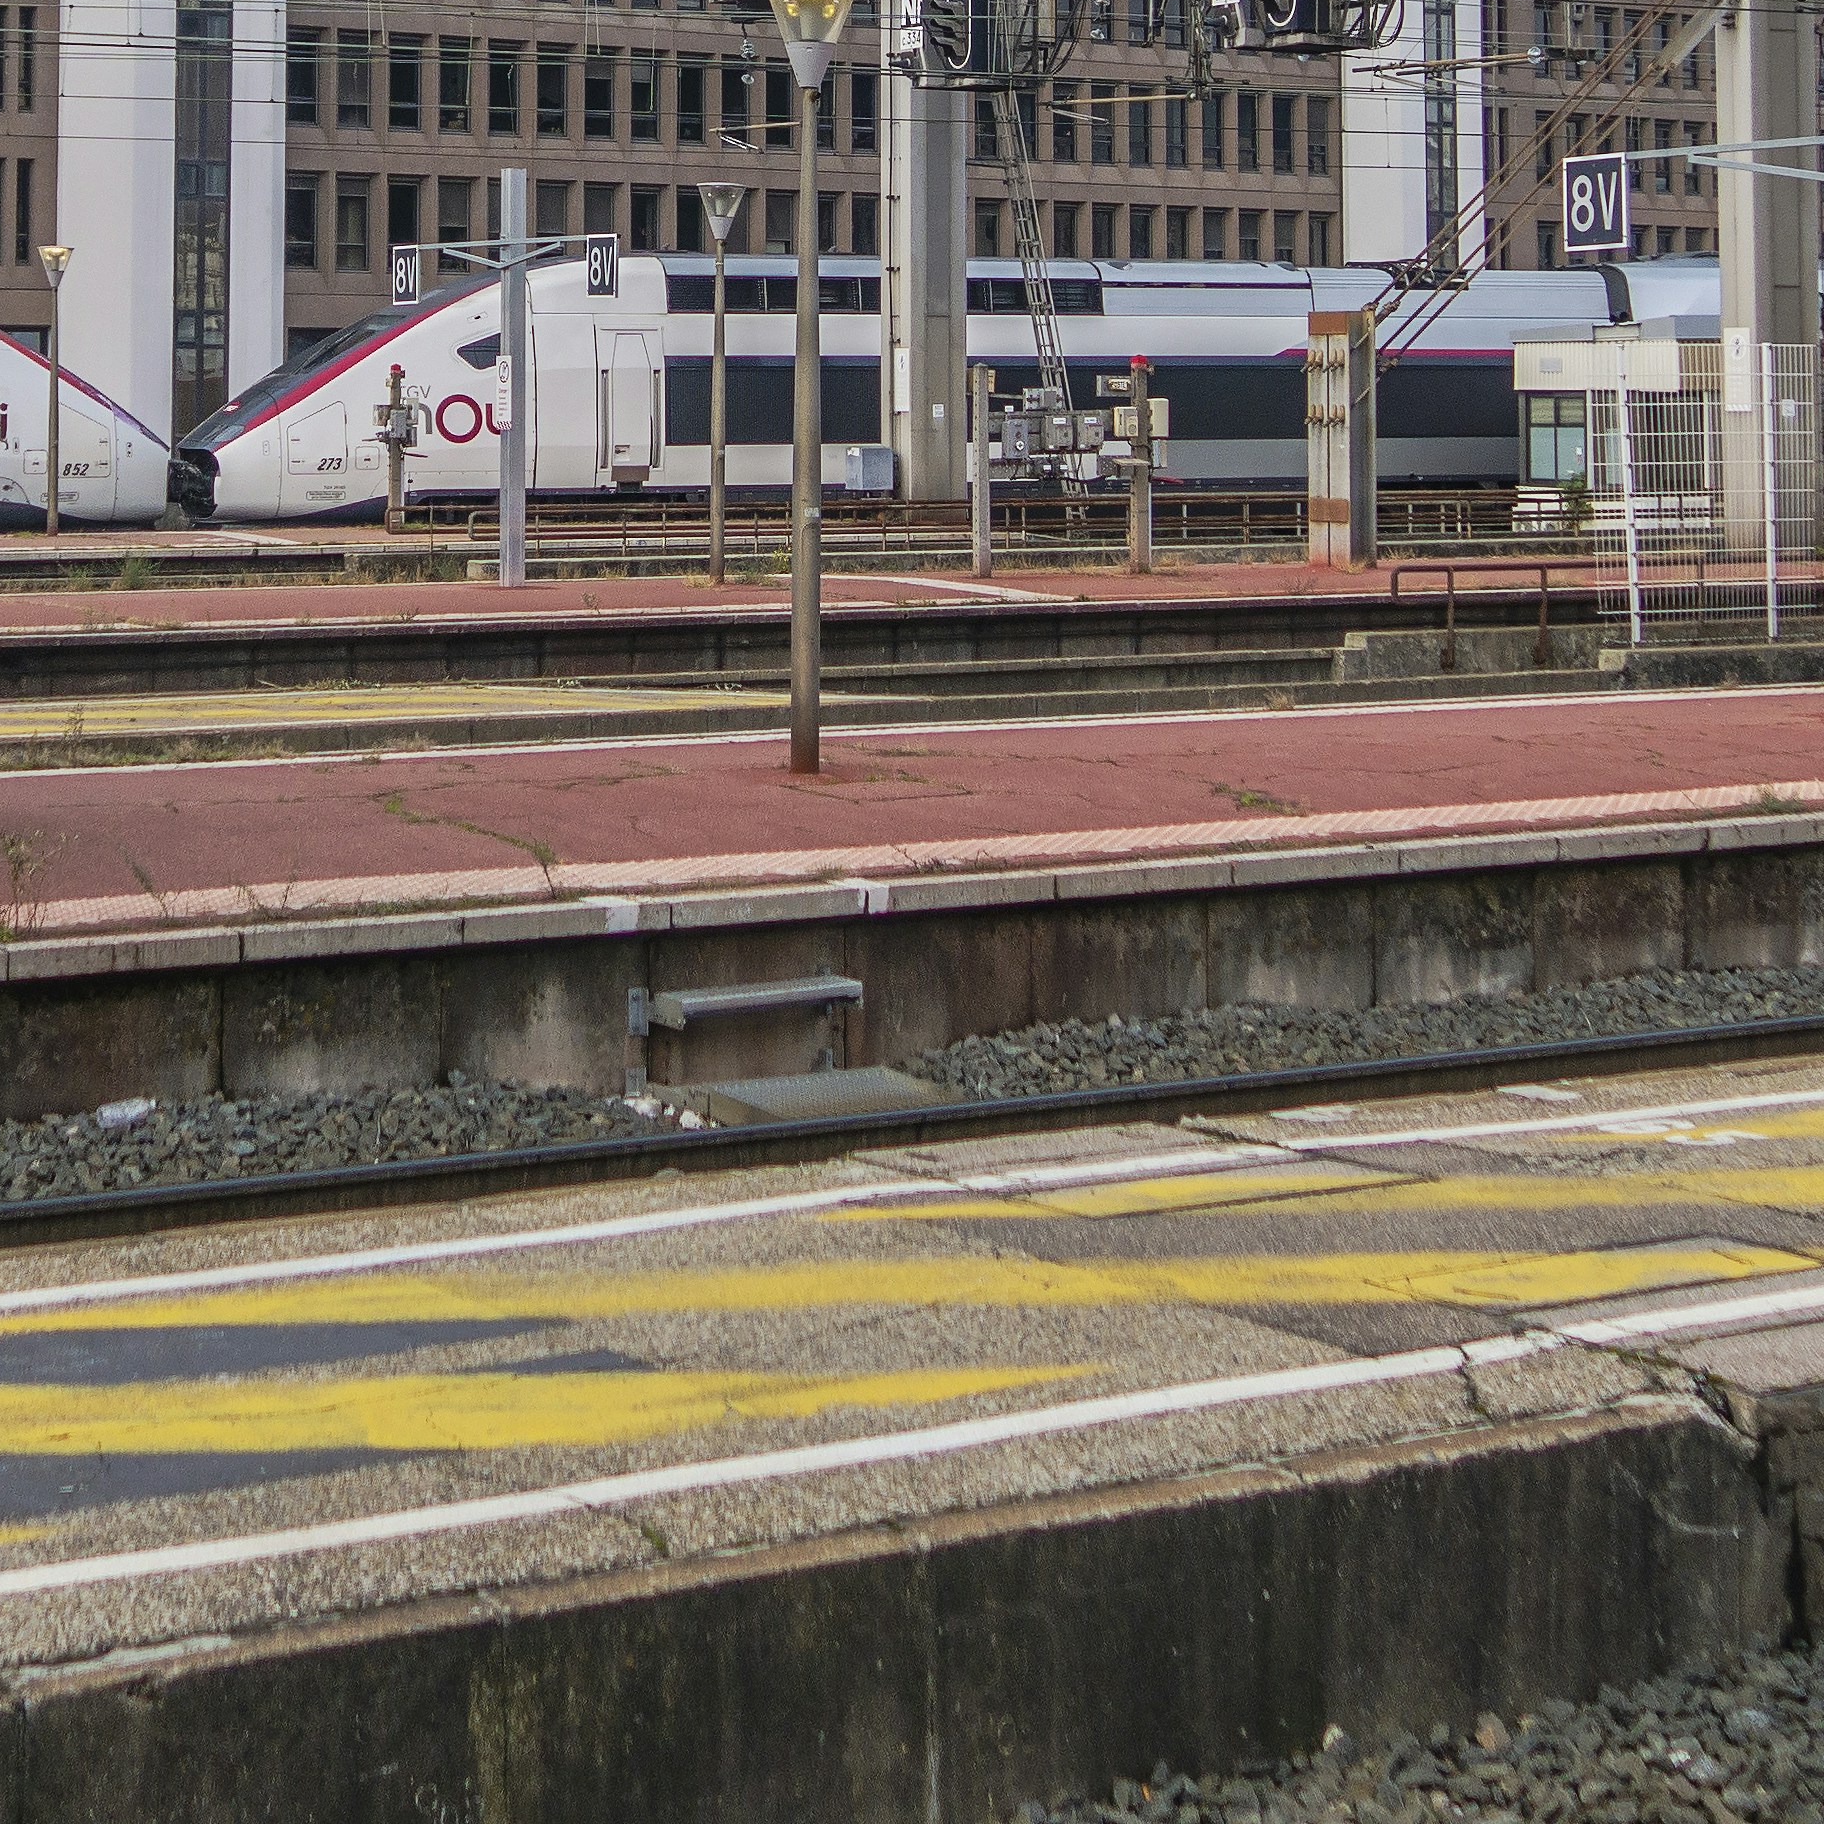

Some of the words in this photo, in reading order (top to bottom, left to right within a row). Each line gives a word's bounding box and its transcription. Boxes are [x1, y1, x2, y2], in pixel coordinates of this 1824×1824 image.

[1571, 171, 1617, 233] 8V
[395, 256, 416, 294] 8V
[590, 246, 613, 286] 8V
[62, 463, 90, 476] 852
[317, 458, 343, 471] 273
